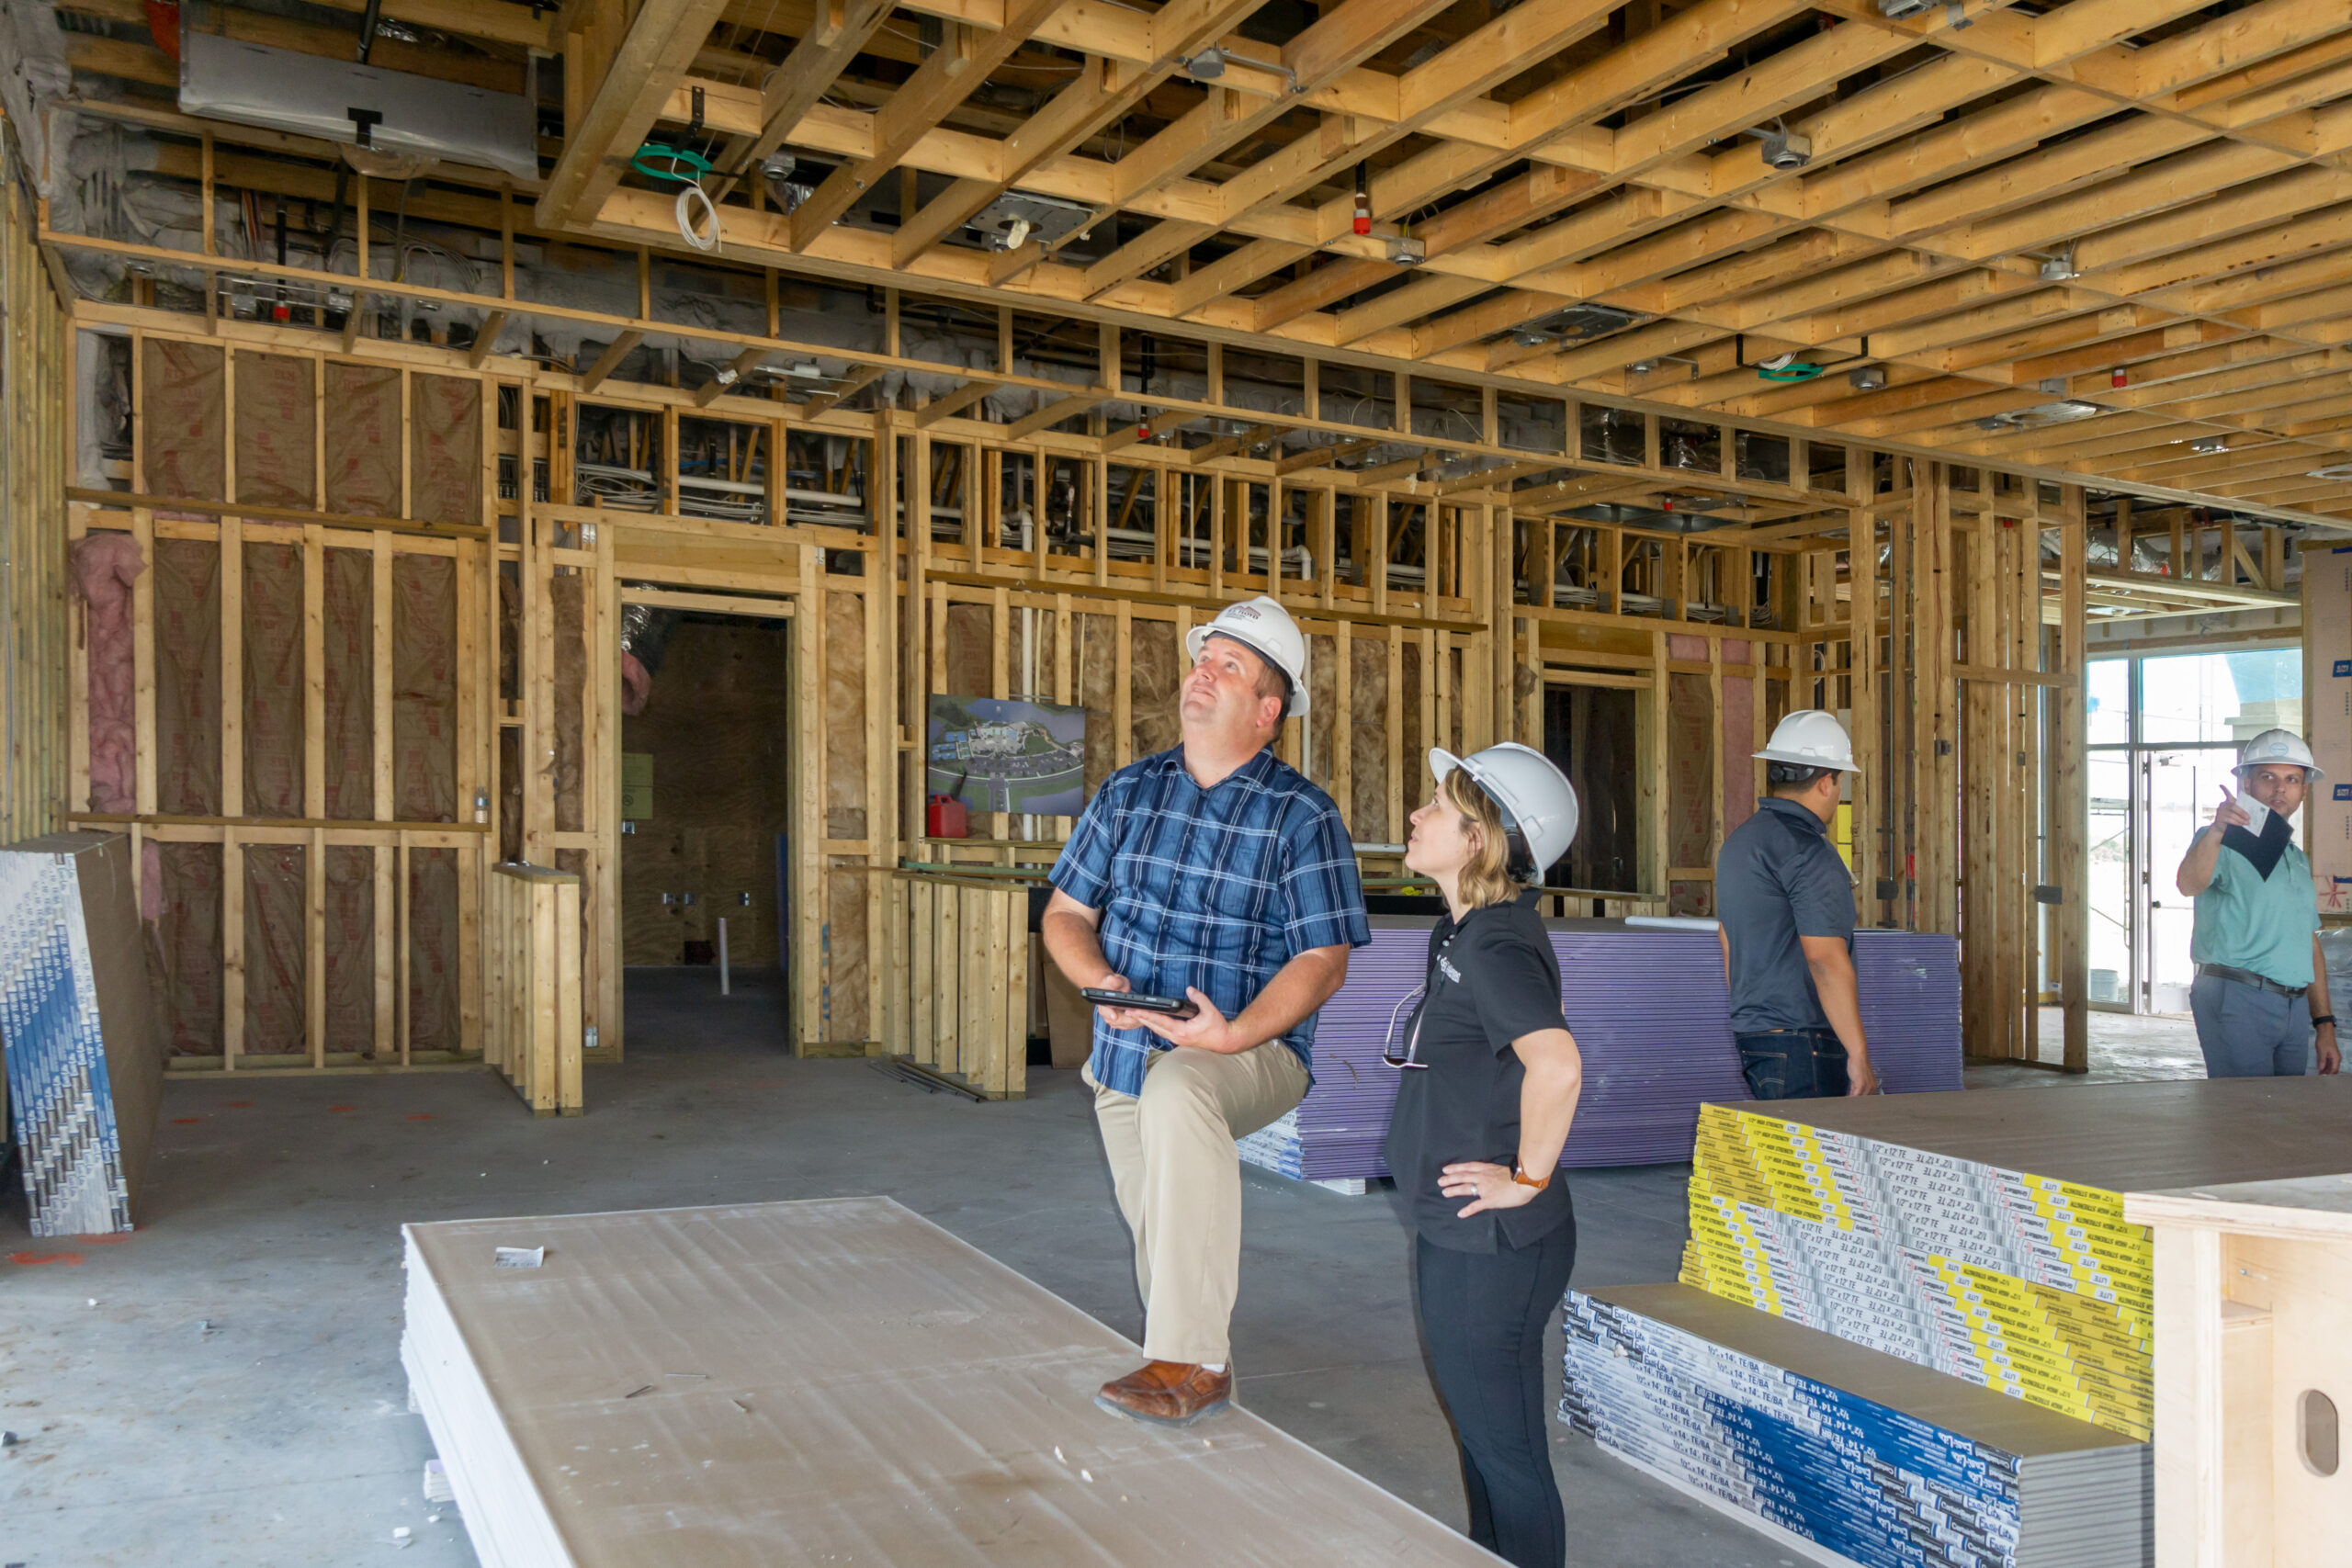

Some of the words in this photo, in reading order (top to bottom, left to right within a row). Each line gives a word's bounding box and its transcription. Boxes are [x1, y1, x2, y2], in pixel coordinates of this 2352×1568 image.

[1906, 1163, 1914, 1171] TE
[1911, 1177, 1918, 1185] TE
[1924, 1205, 1931, 1213] TE
[1815, 1225, 1822, 1234] TE
[1939, 1235, 1948, 1243] TE
[1832, 1253, 1839, 1261] TE
[1849, 1280, 1856, 1289] TE
[1856, 1309, 1863, 1318] TE
[1866, 1337, 1874, 1347] TE
